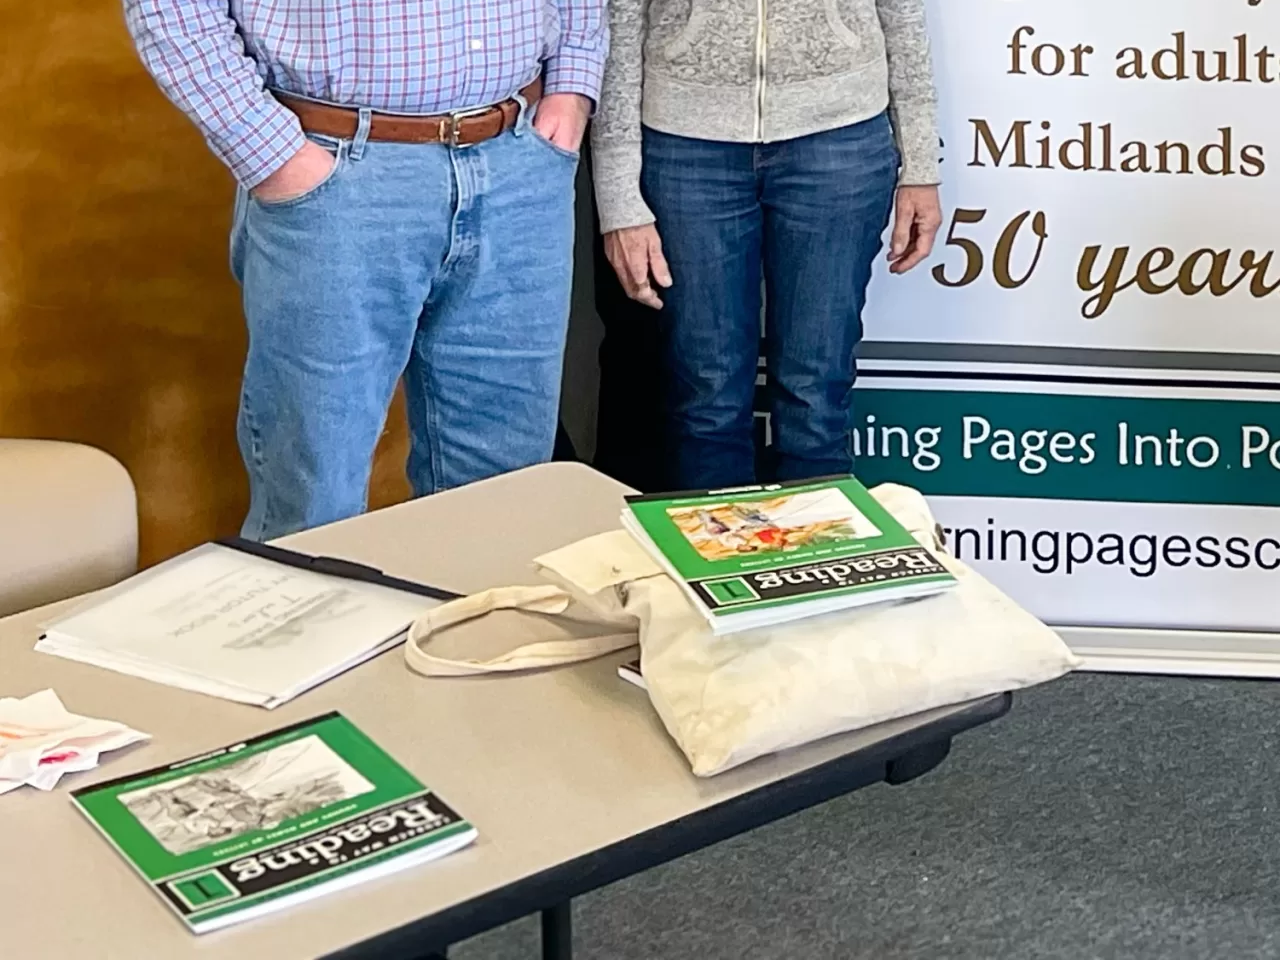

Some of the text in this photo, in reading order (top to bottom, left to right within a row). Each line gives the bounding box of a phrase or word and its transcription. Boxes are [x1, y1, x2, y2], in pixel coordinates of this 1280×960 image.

[1007, 26, 1093, 76] for
[967, 119, 1265, 177] Midlands
[931, 207, 1048, 288] 50
[963, 417, 1095, 473] Pages
[1119, 423, 1219, 467] Into
[712, 582, 741, 598] 1
[754, 551, 939, 590] Reading
[229, 802, 444, 882] Reading
[181, 876, 218, 898] 1
